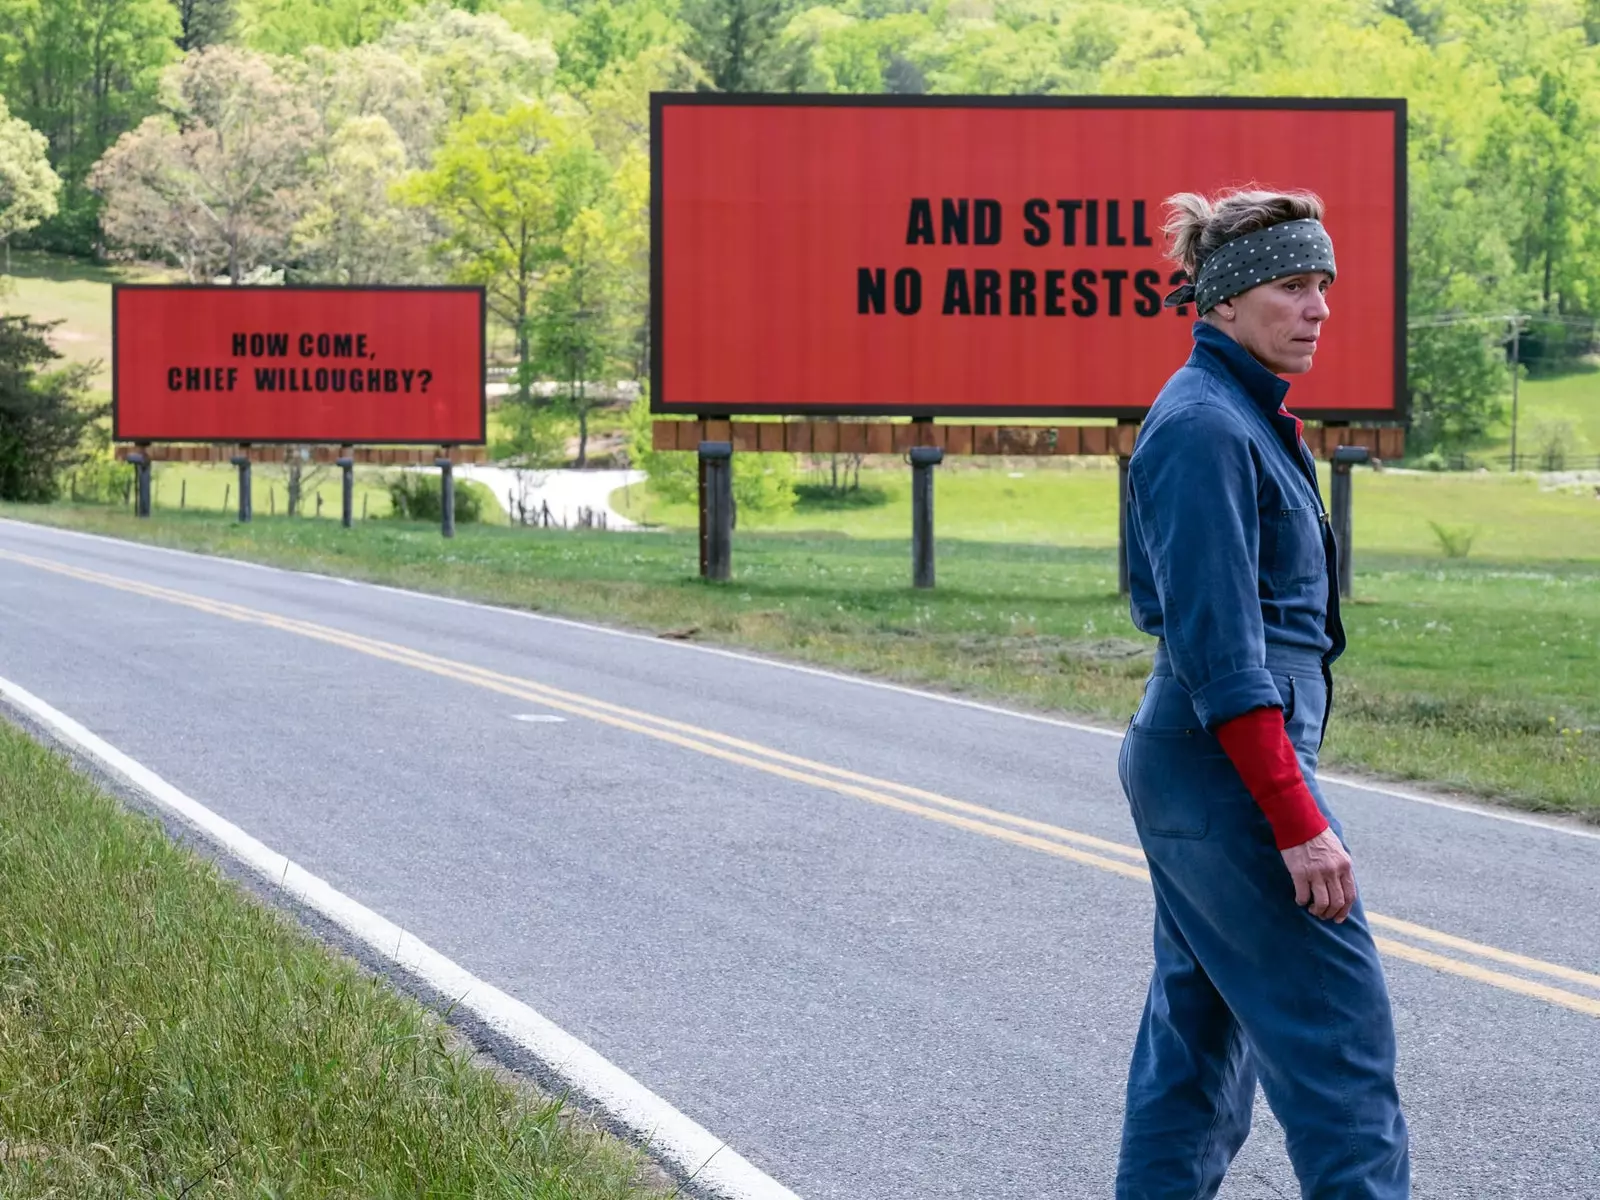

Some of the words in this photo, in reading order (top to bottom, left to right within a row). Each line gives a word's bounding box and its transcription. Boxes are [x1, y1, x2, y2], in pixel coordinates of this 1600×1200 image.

[906, 198, 1003, 247] AND
[1023, 198, 1153, 248] STILL
[857, 267, 923, 317] NO
[232, 332, 290, 358] HOW
[299, 333, 376, 361] COME,
[168, 366, 239, 392] CHIEF
[254, 368, 433, 394] WILLOUGHBY?
